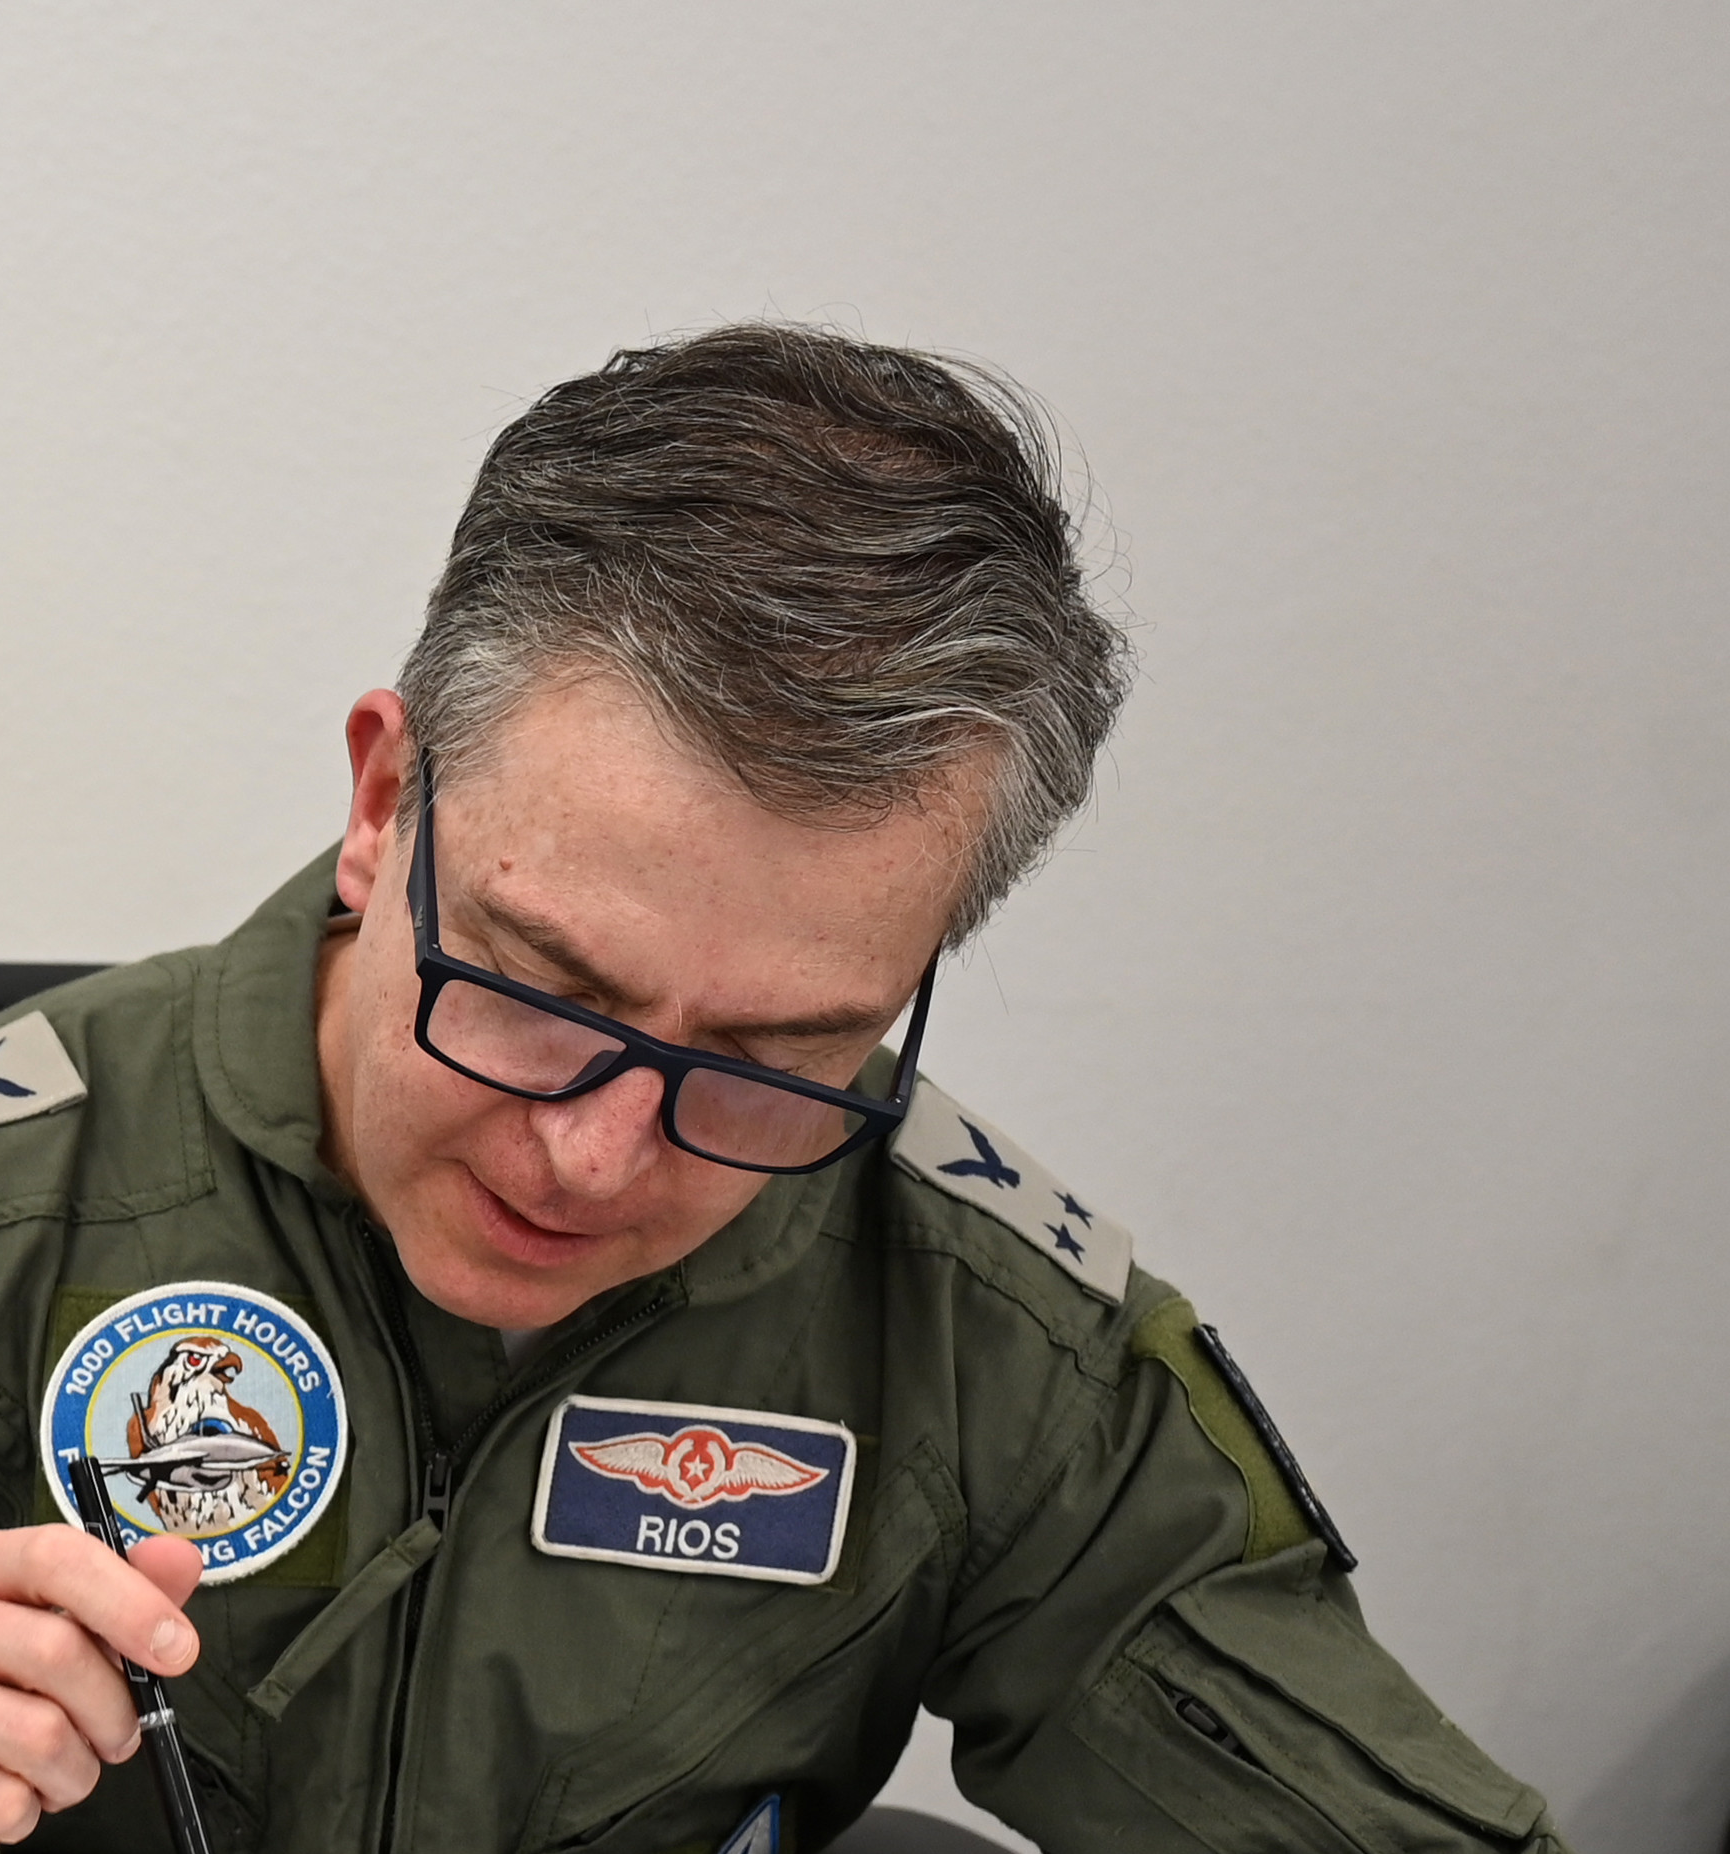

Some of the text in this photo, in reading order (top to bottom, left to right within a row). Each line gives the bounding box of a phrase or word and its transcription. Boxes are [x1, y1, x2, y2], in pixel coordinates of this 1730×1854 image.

[66, 1302, 323, 1396] 1000 FLIGHT HOURS
[243, 1446, 332, 1550] FALCON
[636, 1514, 741, 1561] RIOS
